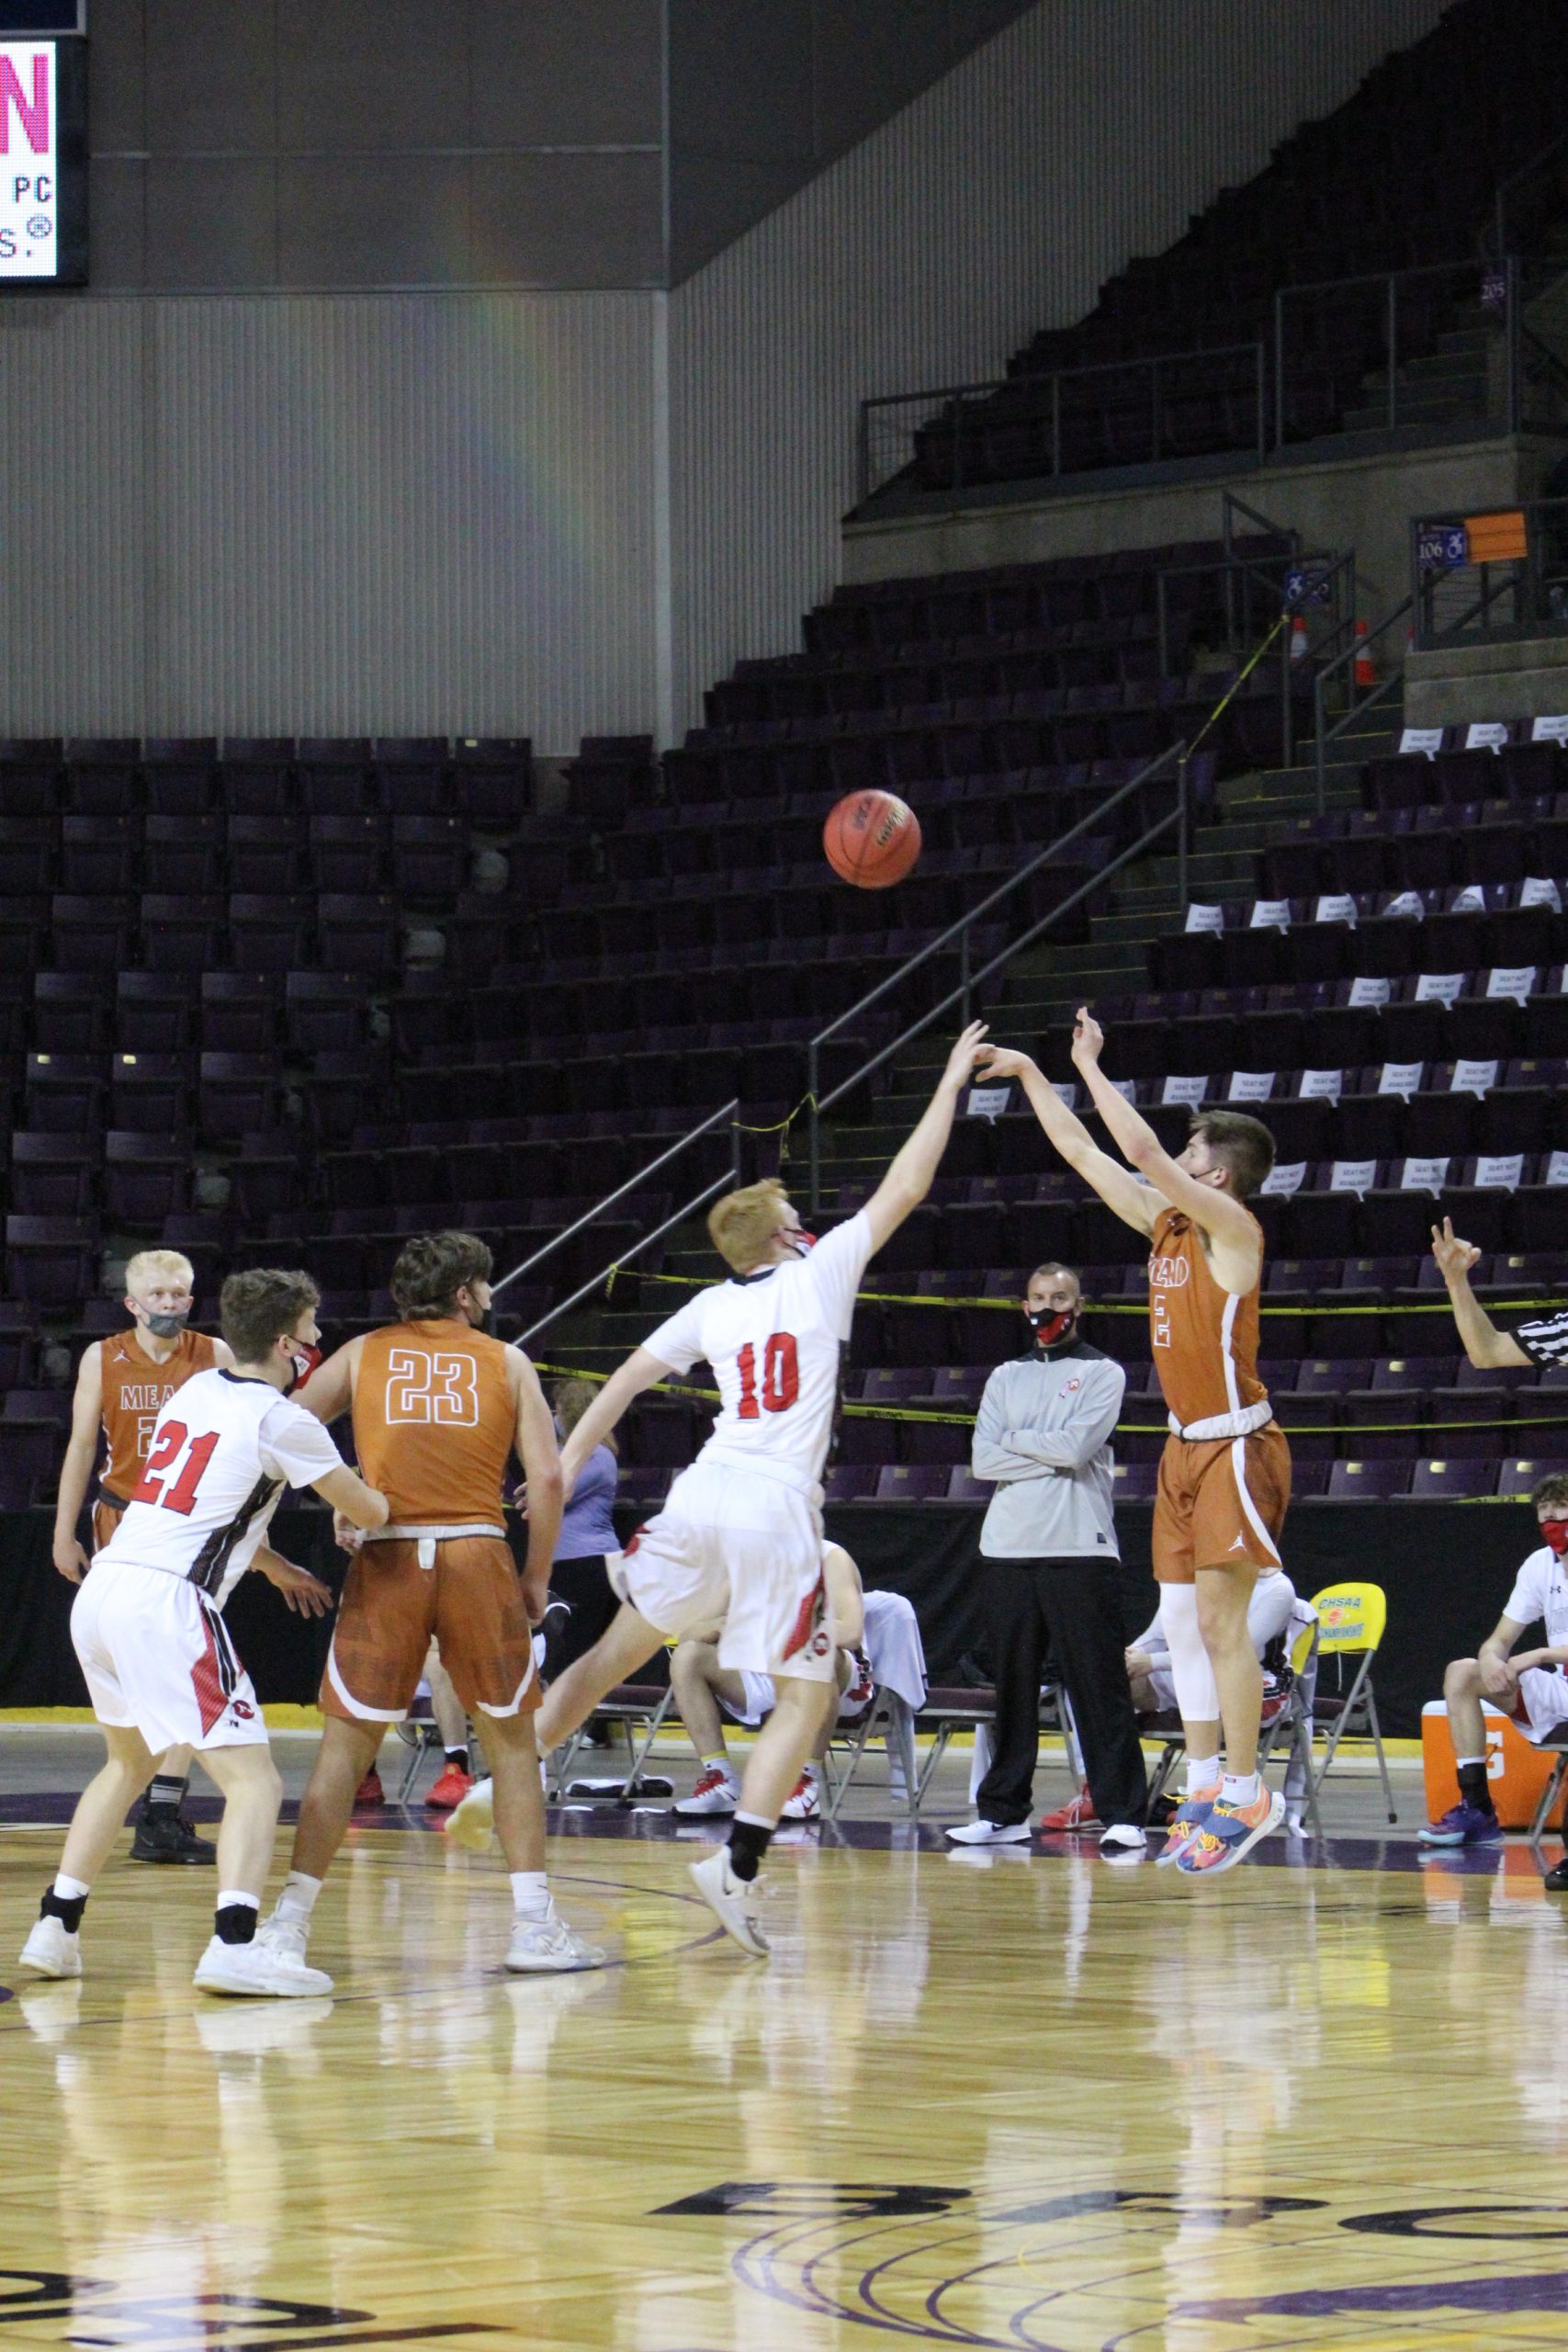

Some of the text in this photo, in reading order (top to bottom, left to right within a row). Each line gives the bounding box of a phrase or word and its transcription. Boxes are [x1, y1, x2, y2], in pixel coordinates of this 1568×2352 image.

[1419, 541, 1442, 559] 106
[120, 1385, 184, 1410] MEA
[386, 1348, 479, 1427] 23
[737, 1331, 799, 1419] 10
[131, 1419, 220, 1516] 21
[1318, 1597, 1362, 1610] CHSAA
